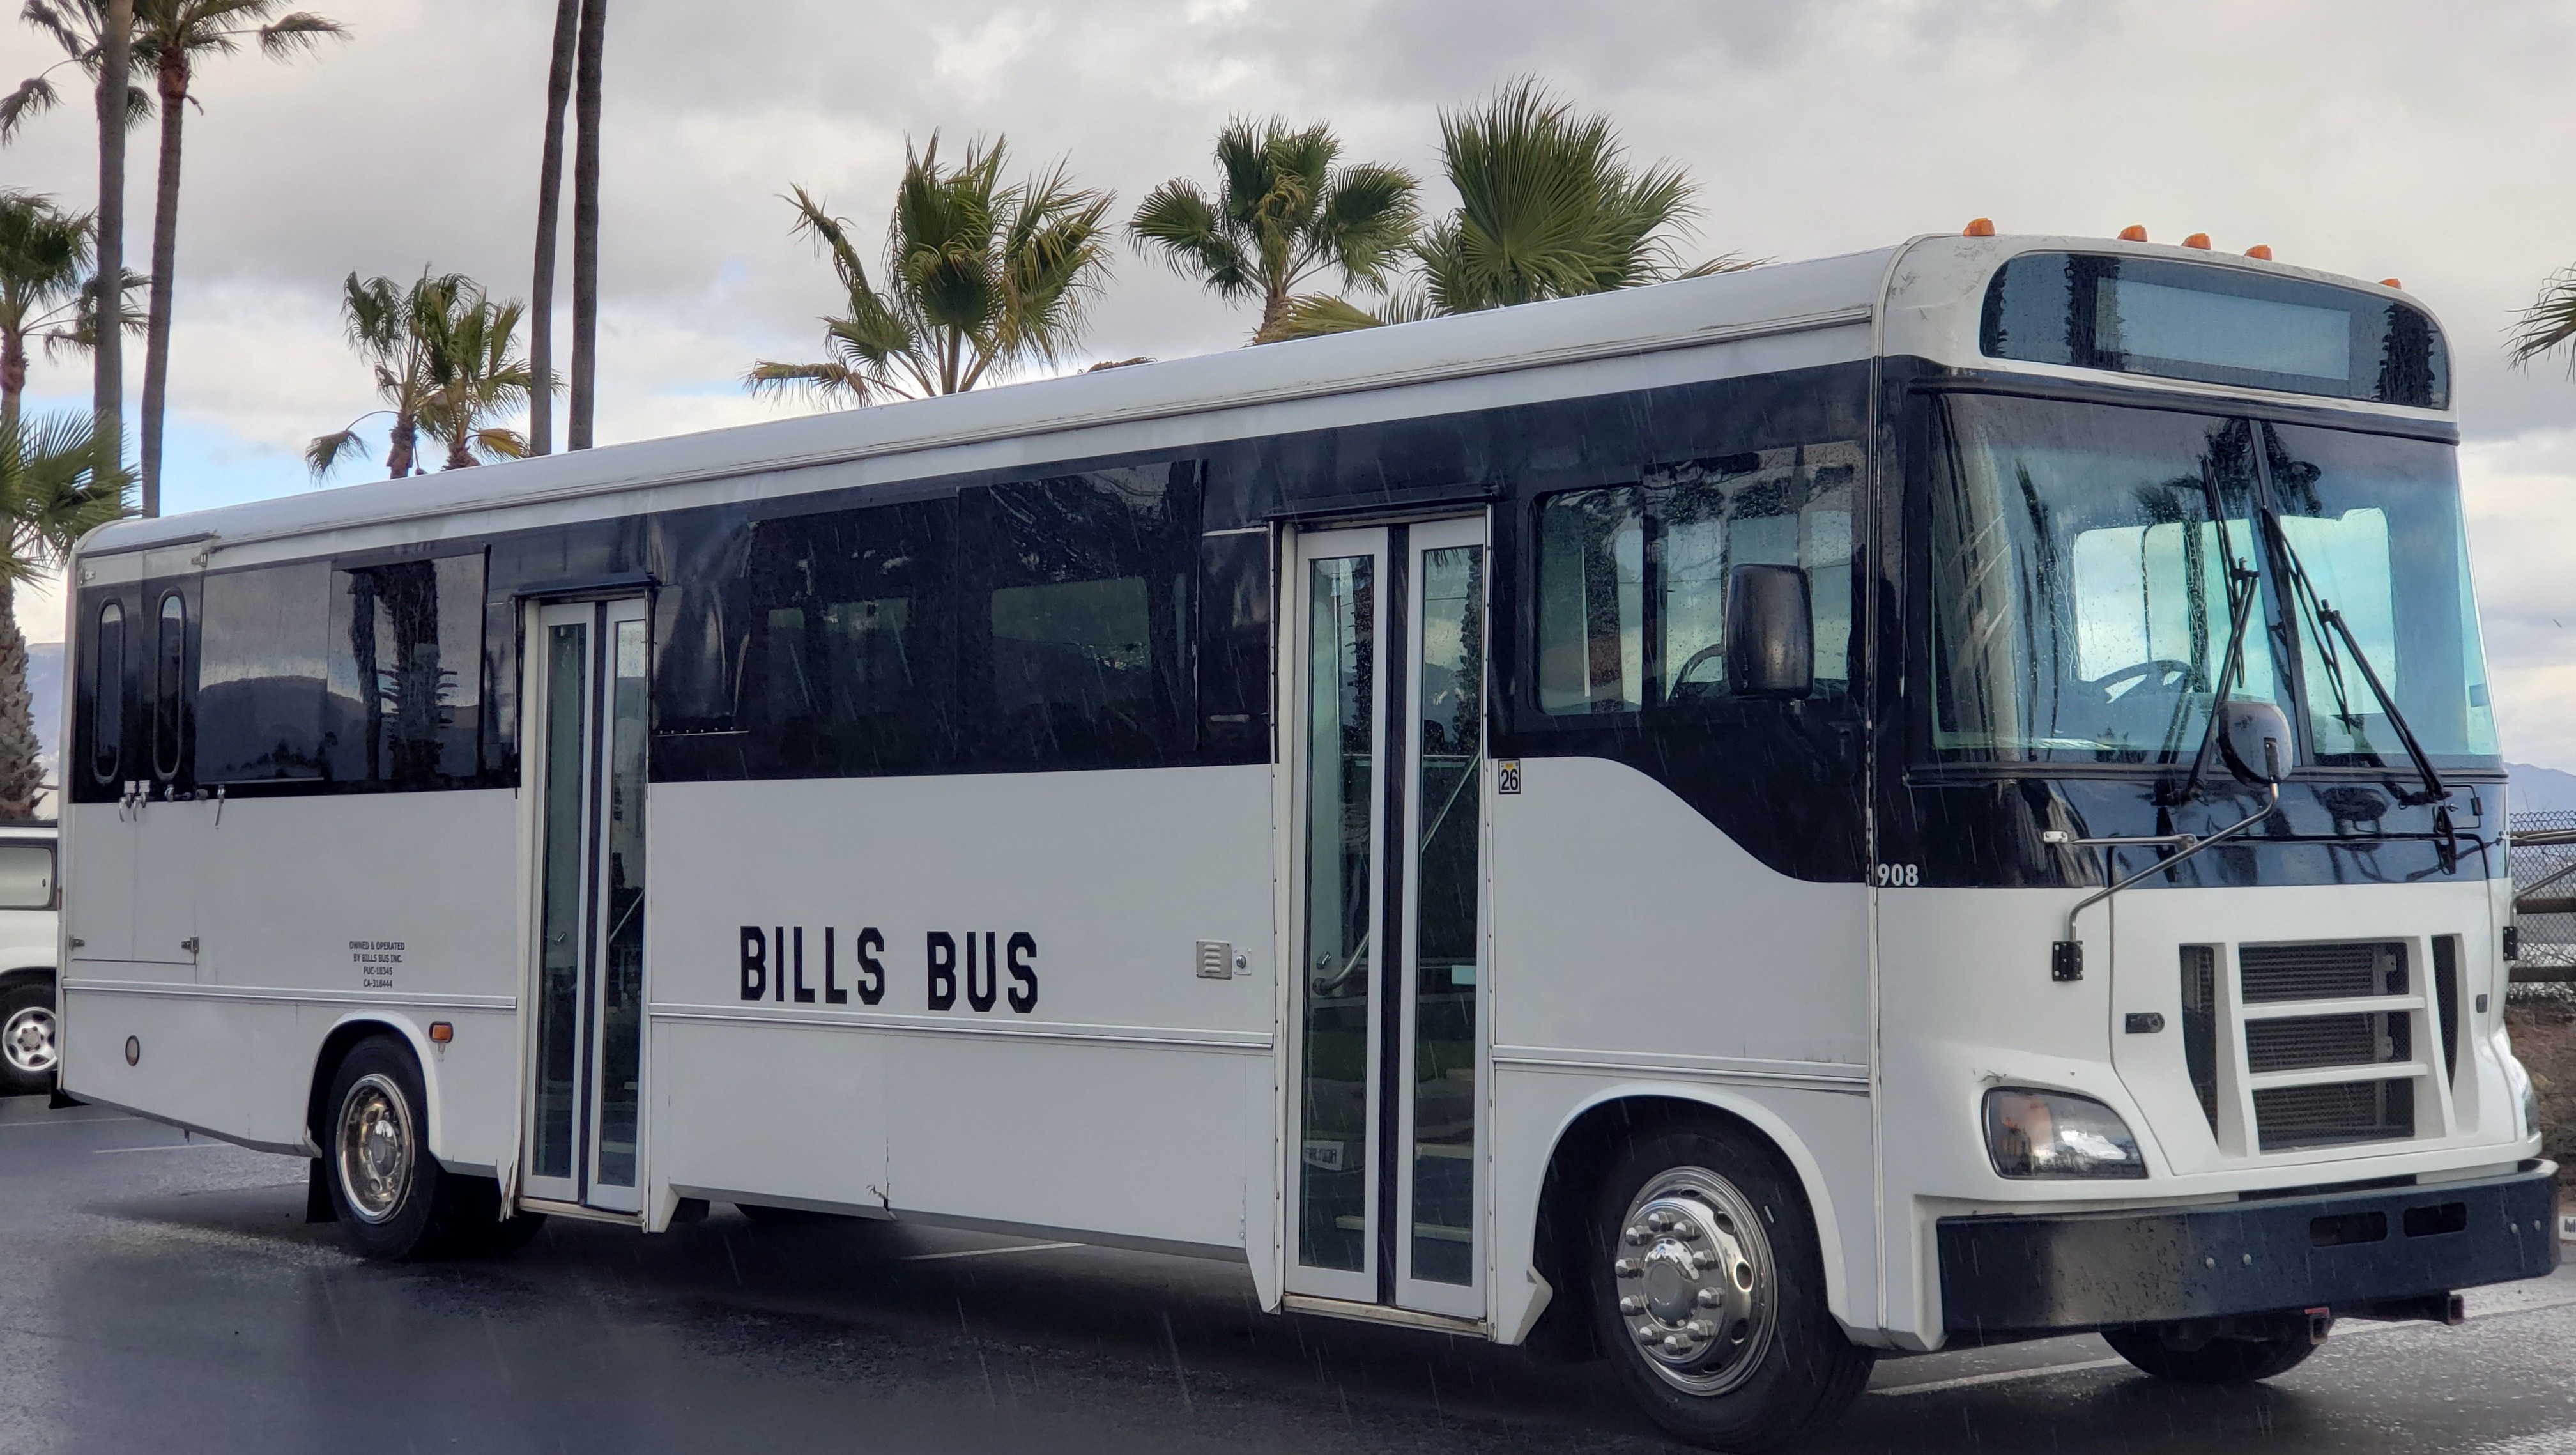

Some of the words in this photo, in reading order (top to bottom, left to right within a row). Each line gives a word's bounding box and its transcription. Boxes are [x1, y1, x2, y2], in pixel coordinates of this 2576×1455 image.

[1501, 768, 1519, 790] 26
[1878, 863, 1919, 886] 908
[349, 941, 370, 950] OWNED
[371, 941, 375, 950] &
[376, 941, 405, 950] OPERATED
[353, 953, 360, 962] BY
[362, 954, 377, 962] BILLS
[378, 954, 389, 963] BUS
[390, 954, 402, 963] INC.
[740, 926, 885, 1005] BILLS
[926, 931, 1038, 1013] BUS
